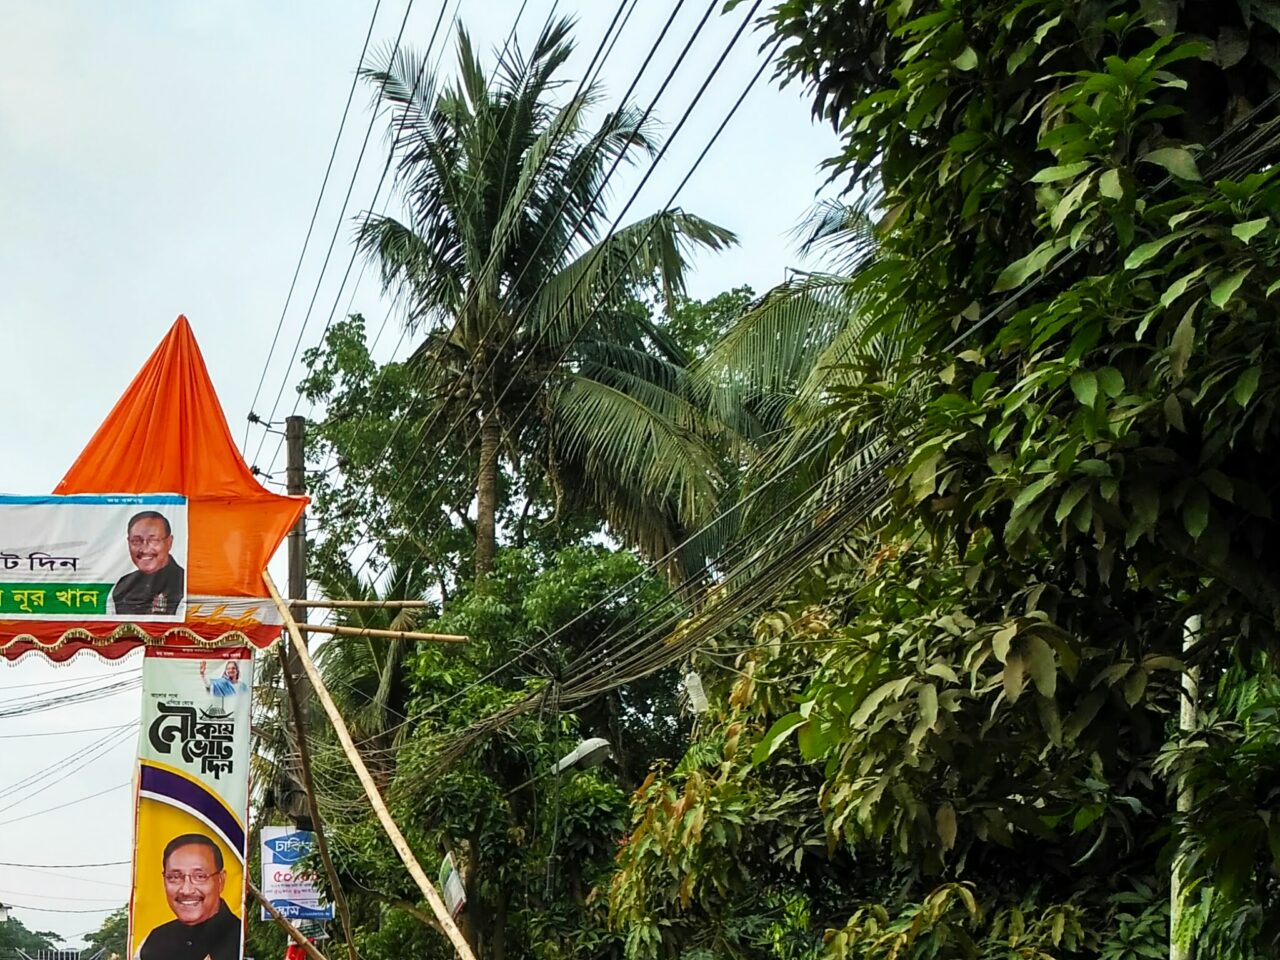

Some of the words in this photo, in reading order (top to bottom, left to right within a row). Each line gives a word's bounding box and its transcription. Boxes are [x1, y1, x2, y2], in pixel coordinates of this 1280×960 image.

[23, 552, 80, 572] দিন
[12, 588, 50, 614] নূর
[56, 589, 100, 609] খান
[149, 701, 235, 754] নৌকায়
[182, 735, 233, 763] ভোট
[201, 755, 233, 780] দিন
